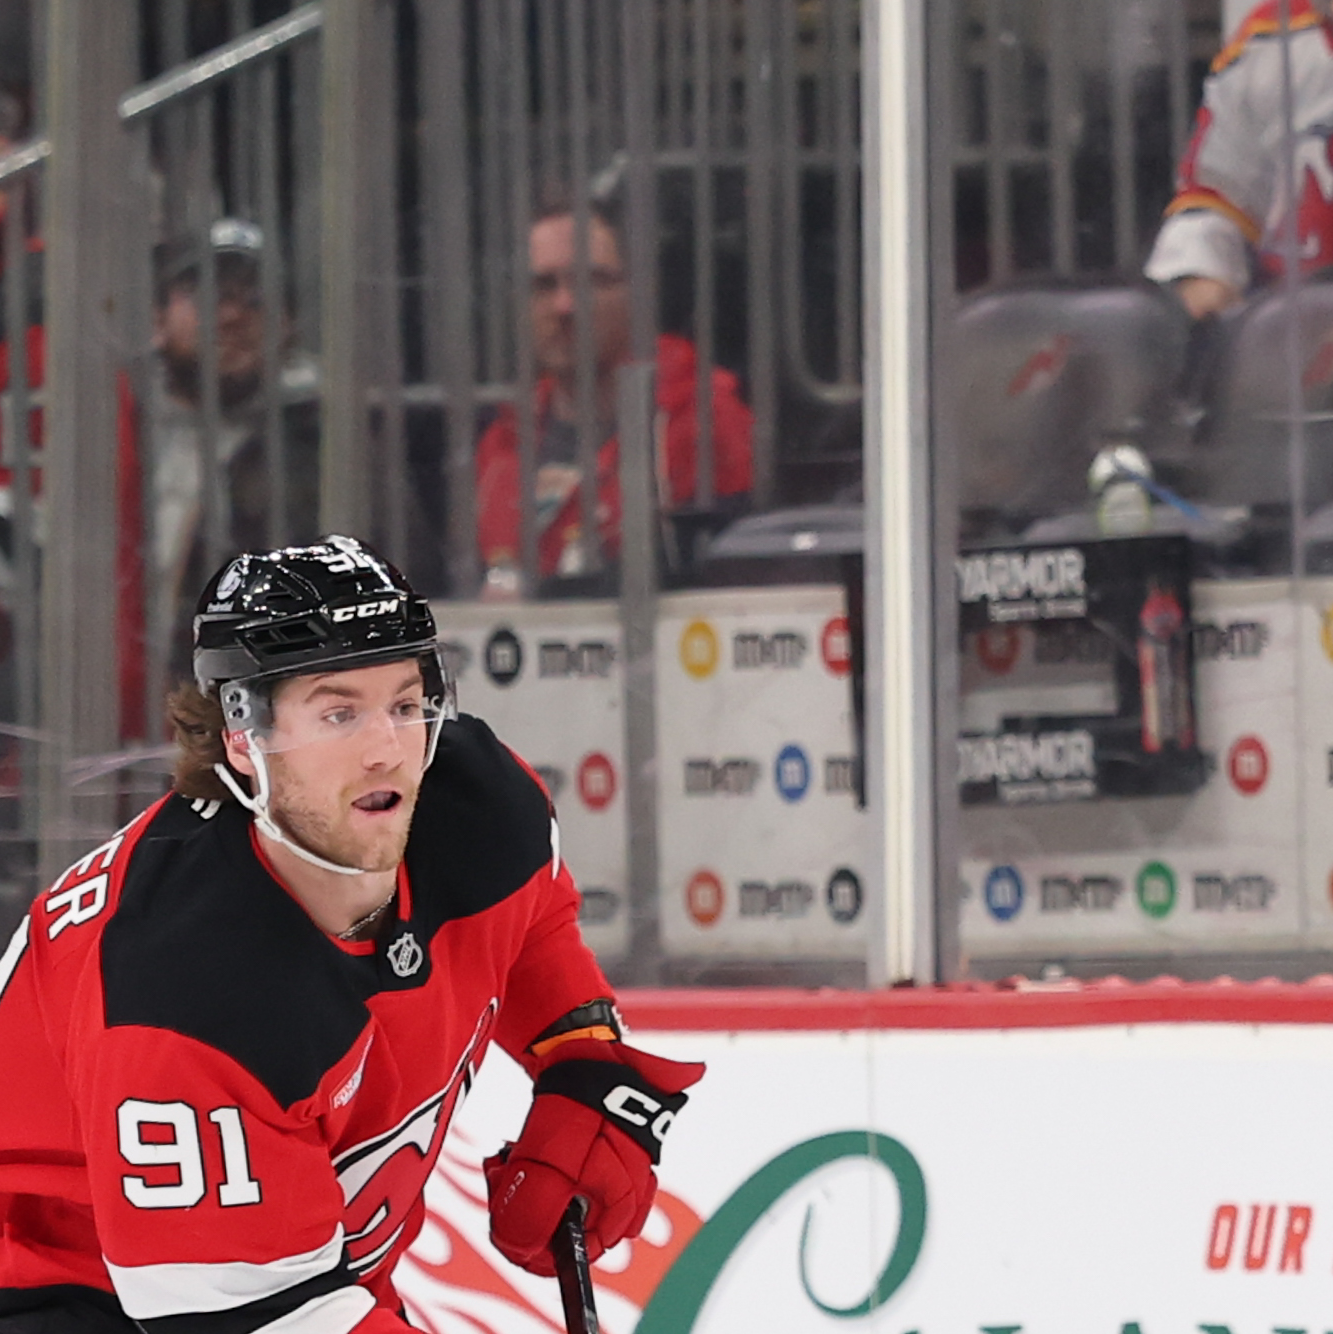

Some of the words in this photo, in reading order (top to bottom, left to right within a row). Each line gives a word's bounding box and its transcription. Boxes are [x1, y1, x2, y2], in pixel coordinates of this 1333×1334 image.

[334, 599, 399, 623] CCM
[46, 811, 147, 942] ER
[116, 1096, 263, 1211] 91
[1206, 1204, 1314, 1274] OUR
